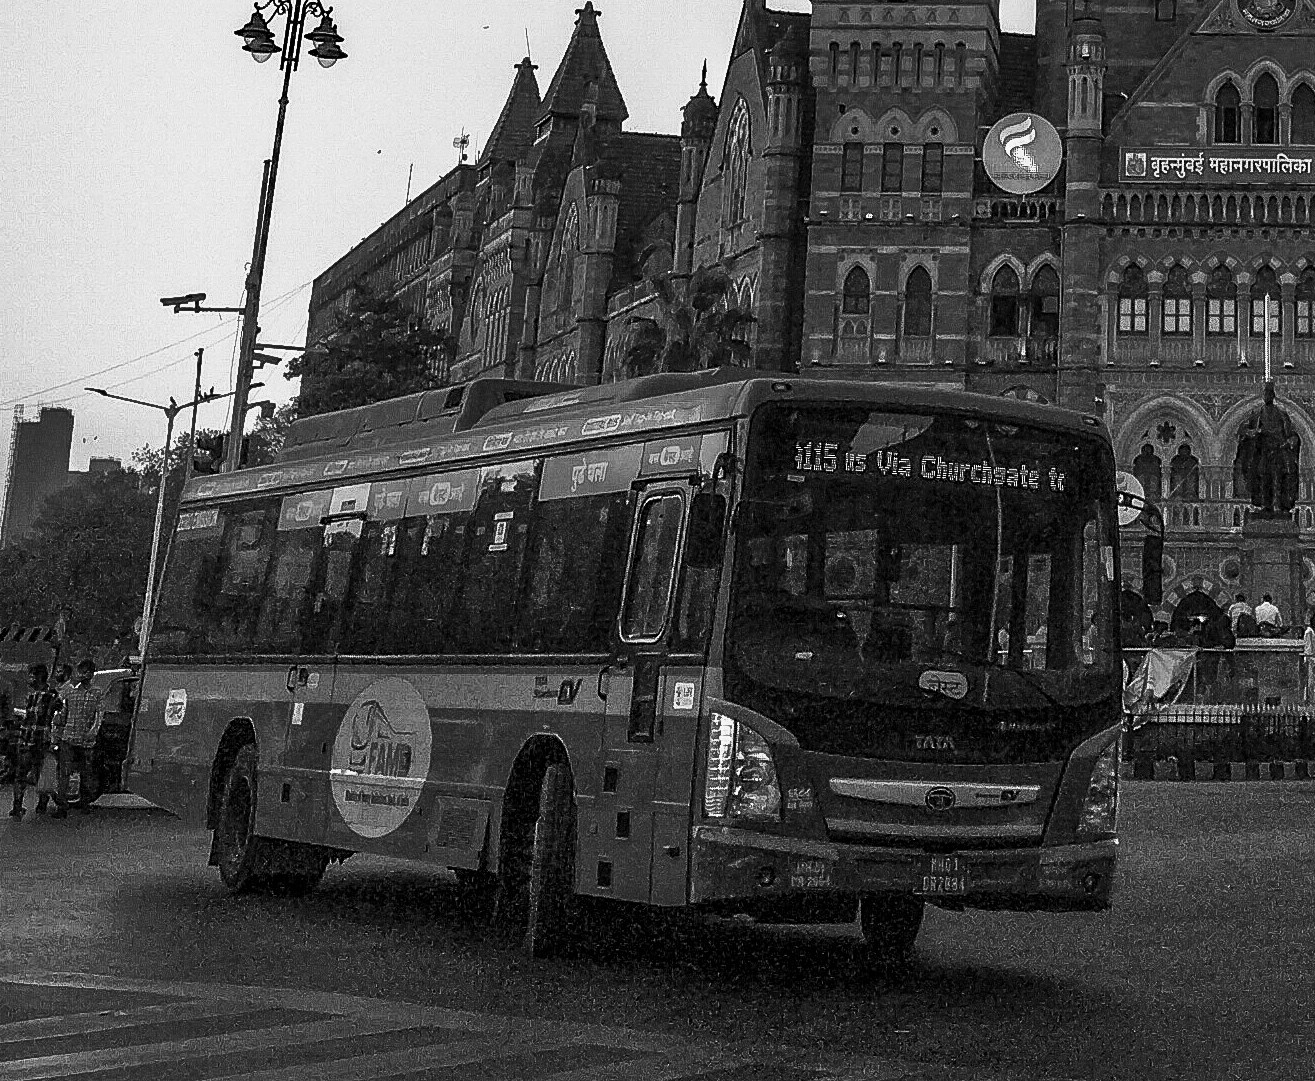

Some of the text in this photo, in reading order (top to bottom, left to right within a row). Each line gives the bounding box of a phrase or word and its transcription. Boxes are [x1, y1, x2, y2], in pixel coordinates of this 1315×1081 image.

[1209, 153, 1312, 175] महानगरपालिका
[877, 450, 912, 478] Via
[920, 454, 1040, 490] Churchgate
